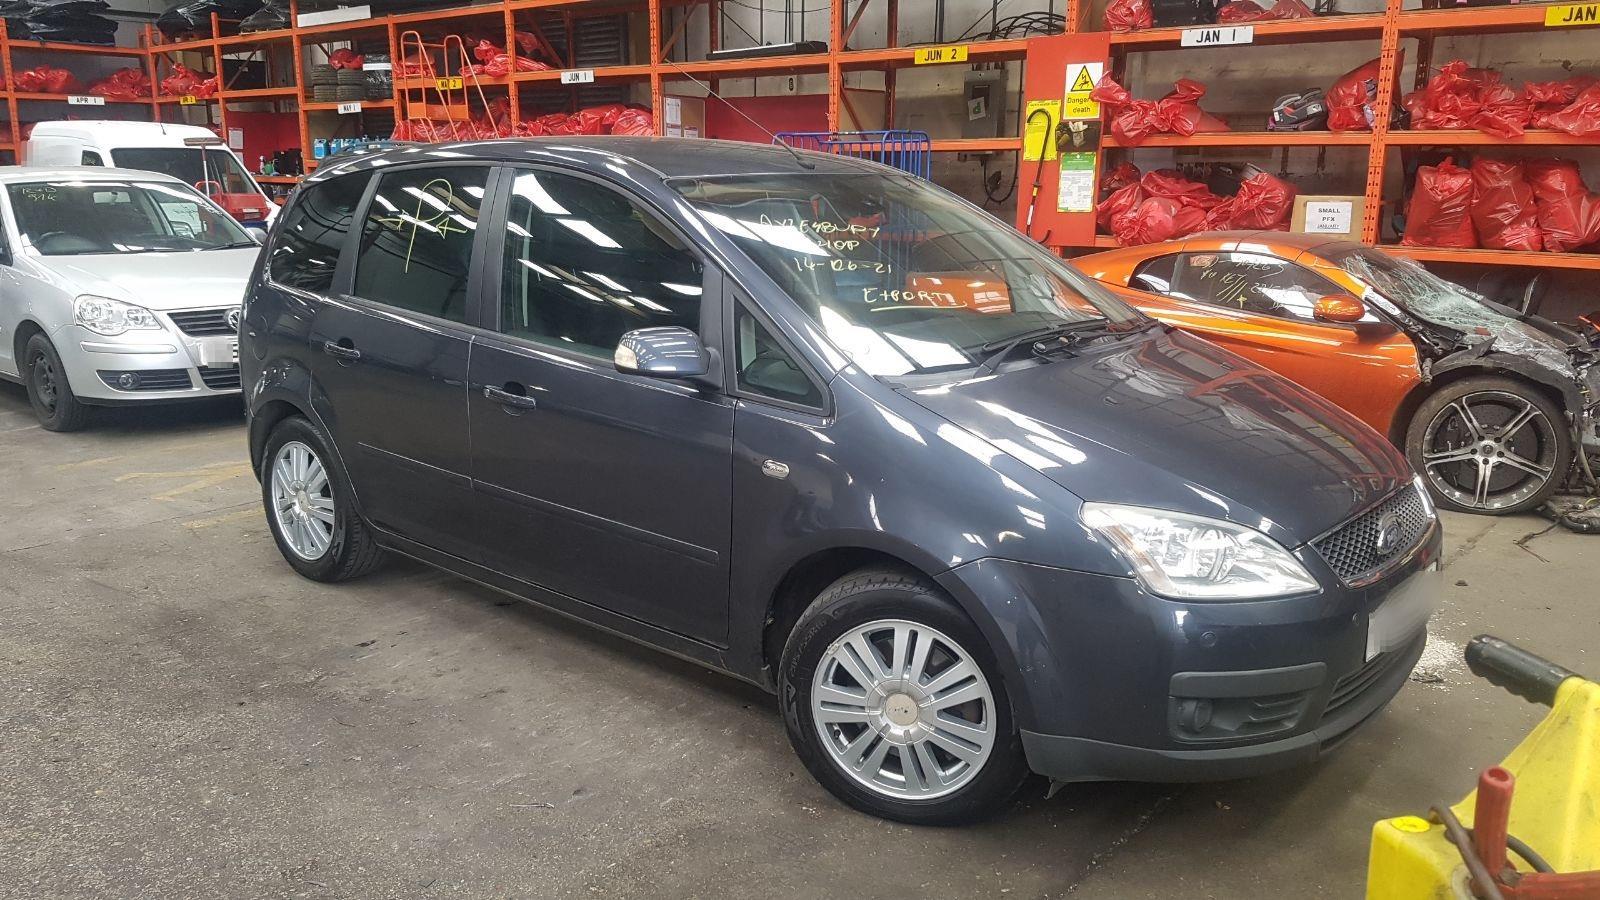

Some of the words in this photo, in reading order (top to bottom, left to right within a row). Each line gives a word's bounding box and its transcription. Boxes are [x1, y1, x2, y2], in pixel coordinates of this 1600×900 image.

[1562, 5, 1598, 22] JAN
[1196, 29, 1220, 43] JAN
[924, 49, 942, 62] JUN
[951, 48, 957, 60] 2
[452, 79, 457, 88] 2
[568, 72, 580, 82] JUN
